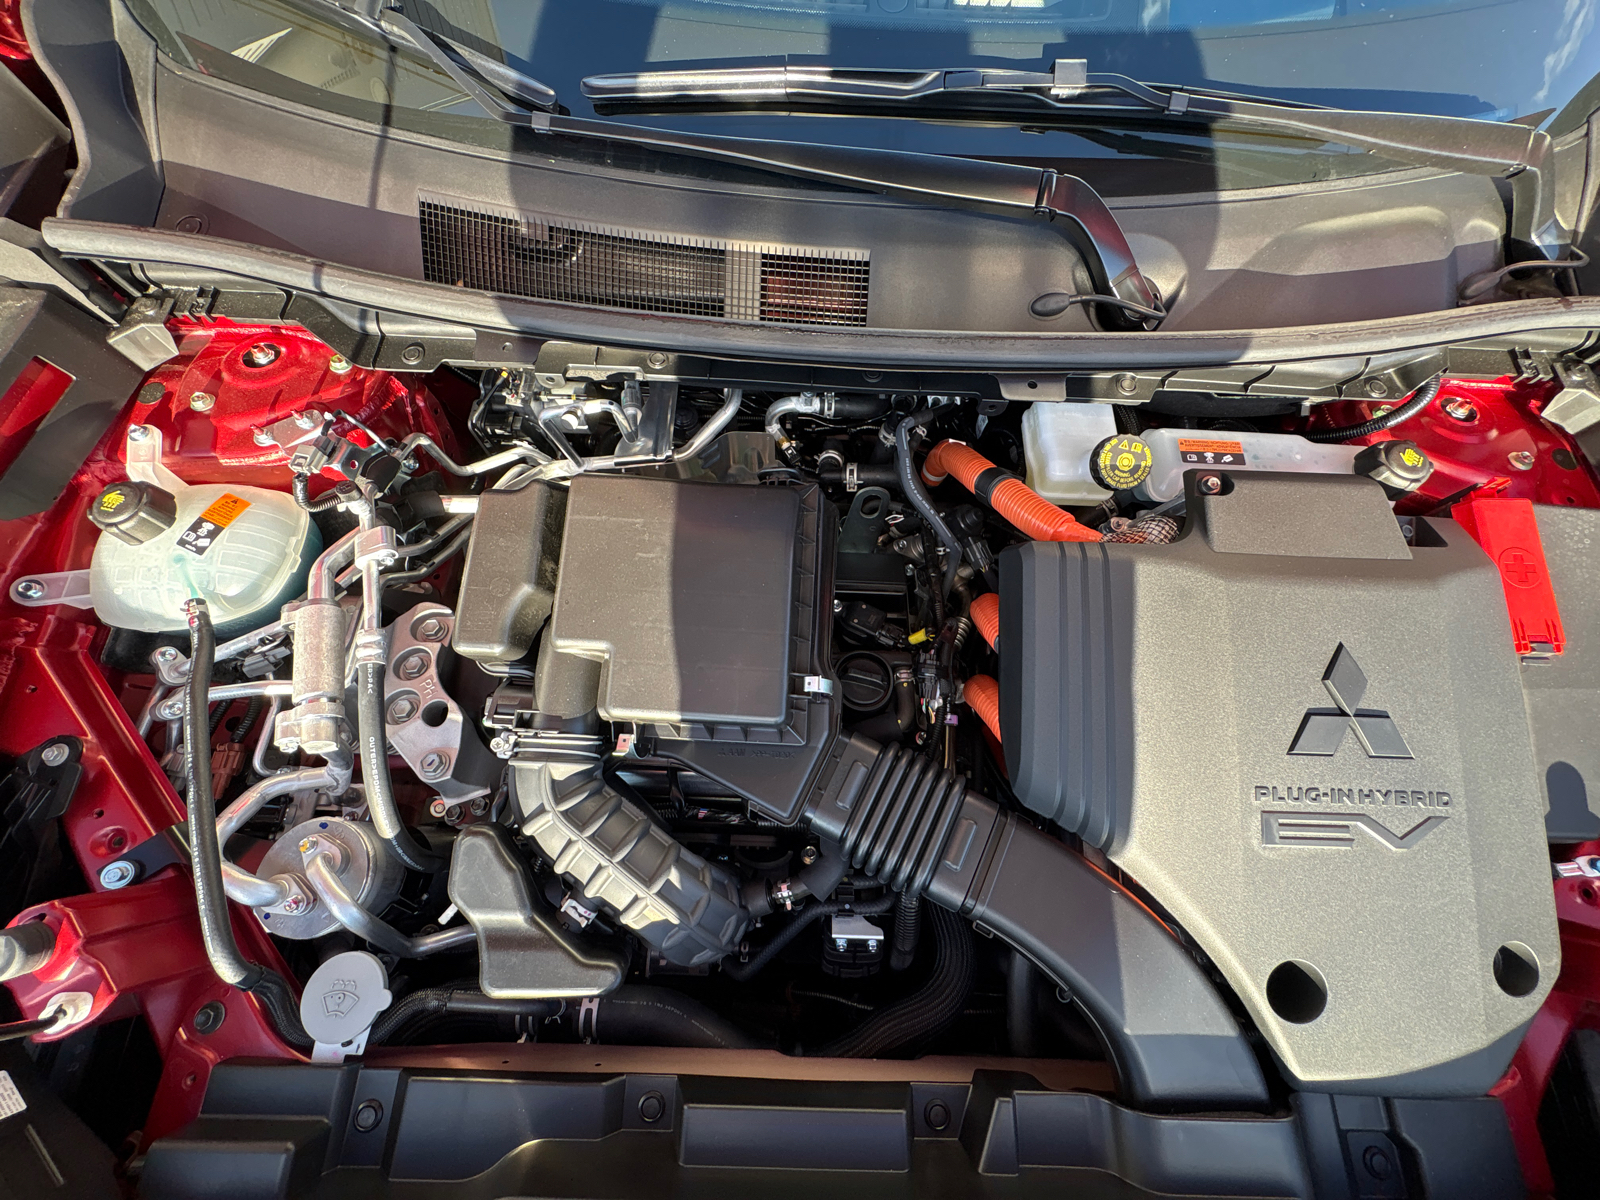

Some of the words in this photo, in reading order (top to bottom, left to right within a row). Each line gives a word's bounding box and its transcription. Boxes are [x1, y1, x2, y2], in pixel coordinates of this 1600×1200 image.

[1255, 786, 1354, 805] PLUG-IN
[1358, 789, 1453, 807] HYBRID
[1261, 811, 1450, 850] EV
